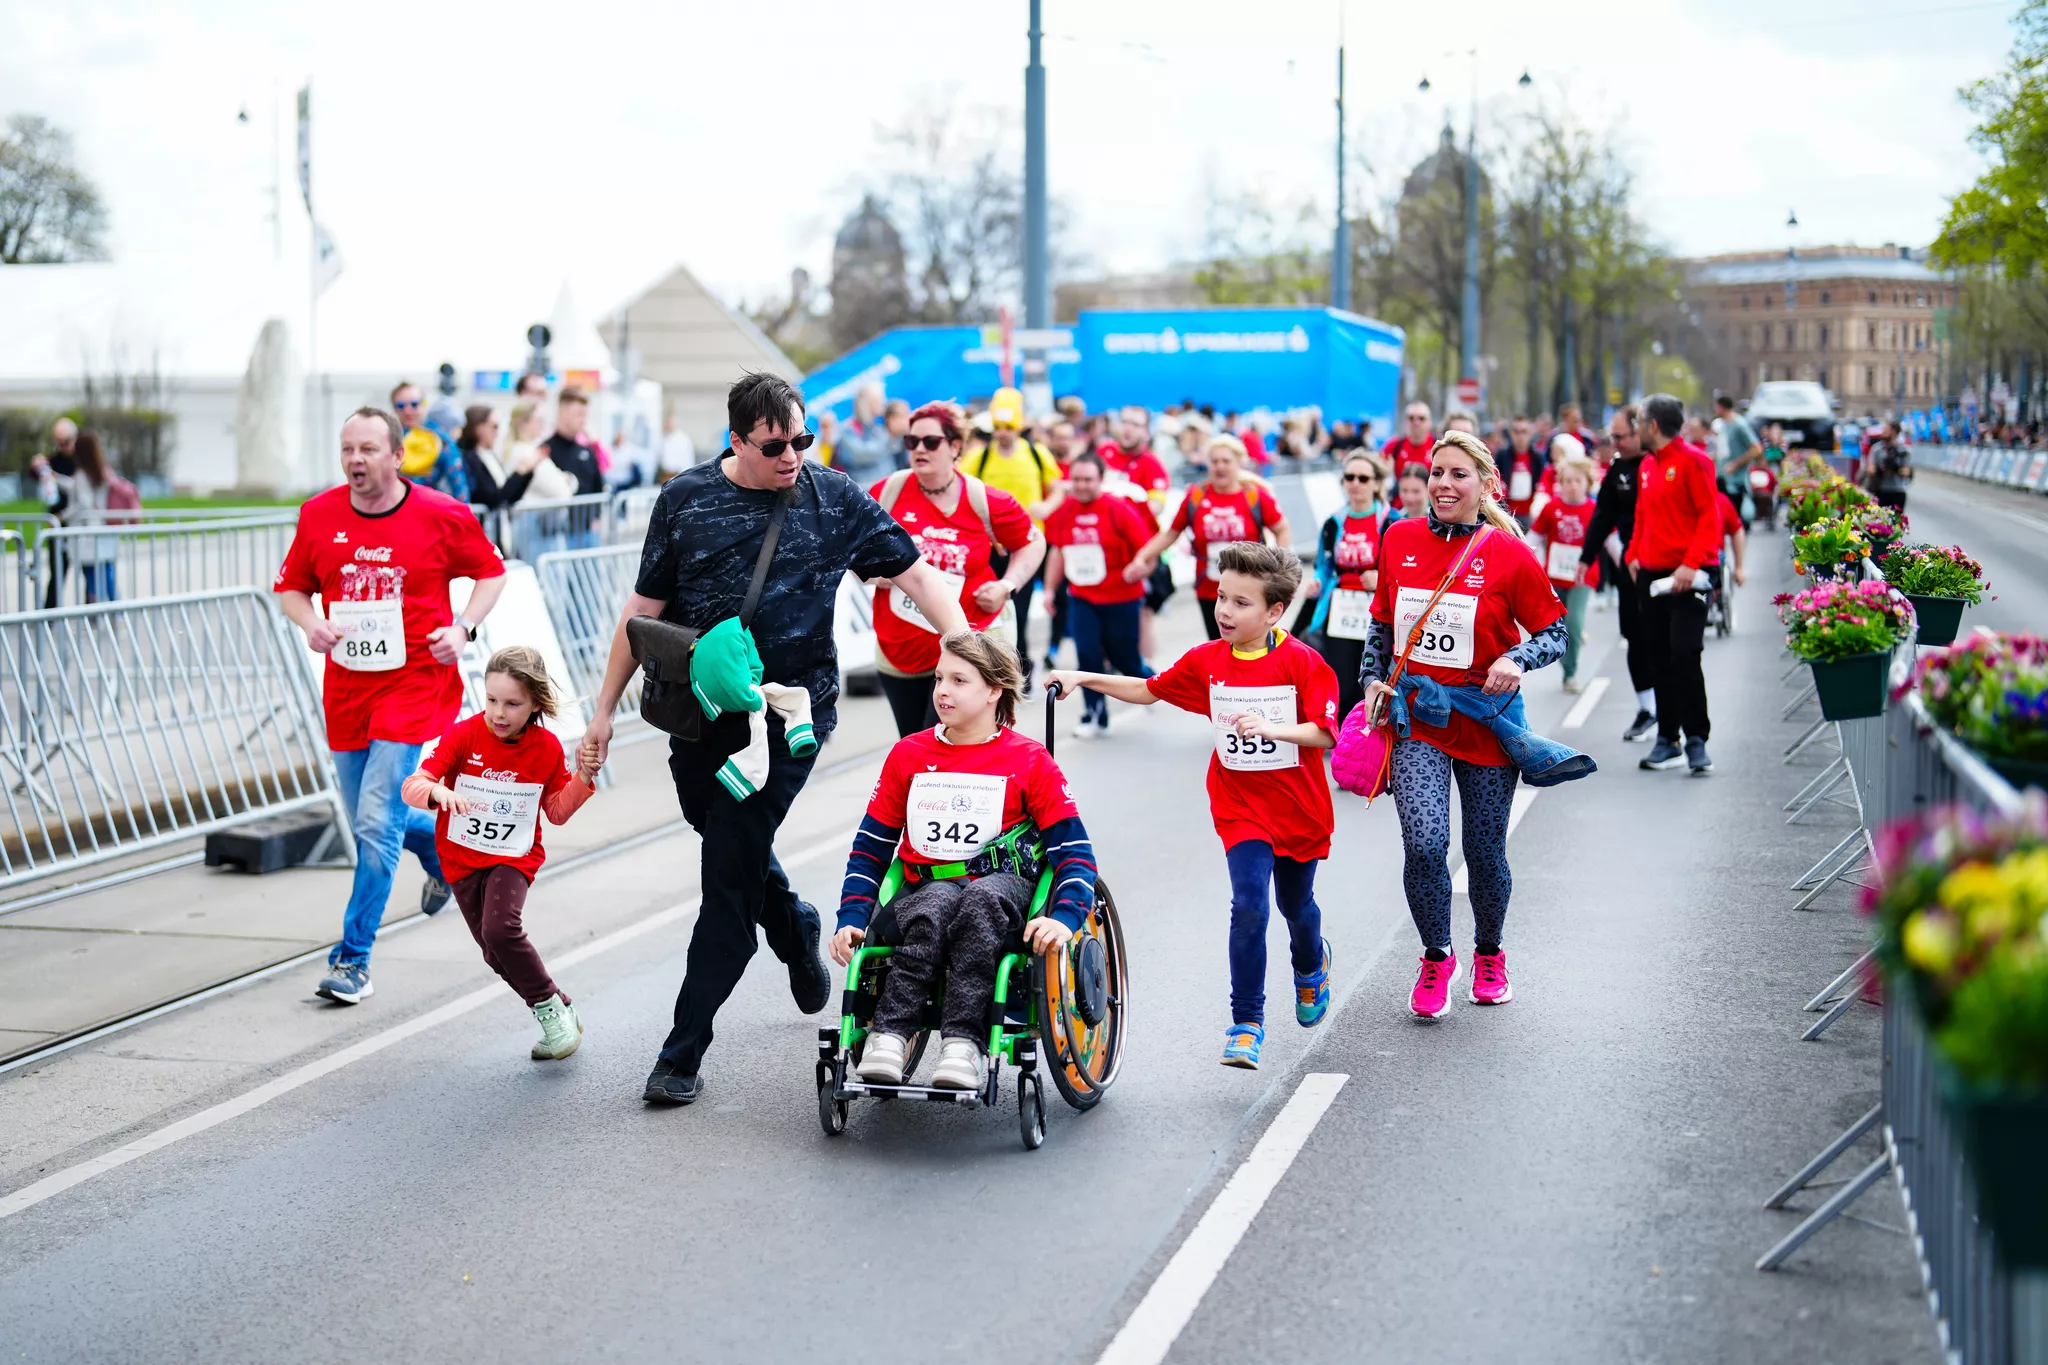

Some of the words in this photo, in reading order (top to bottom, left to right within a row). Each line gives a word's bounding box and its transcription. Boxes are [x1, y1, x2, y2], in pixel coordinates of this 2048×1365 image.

[346, 640, 388, 657] 884
[1226, 733, 1277, 755] 355
[461, 782, 485, 791] Laufend
[485, 788, 512, 796] Inklusion
[466, 818, 516, 840] 357
[926, 821, 979, 844] 342
